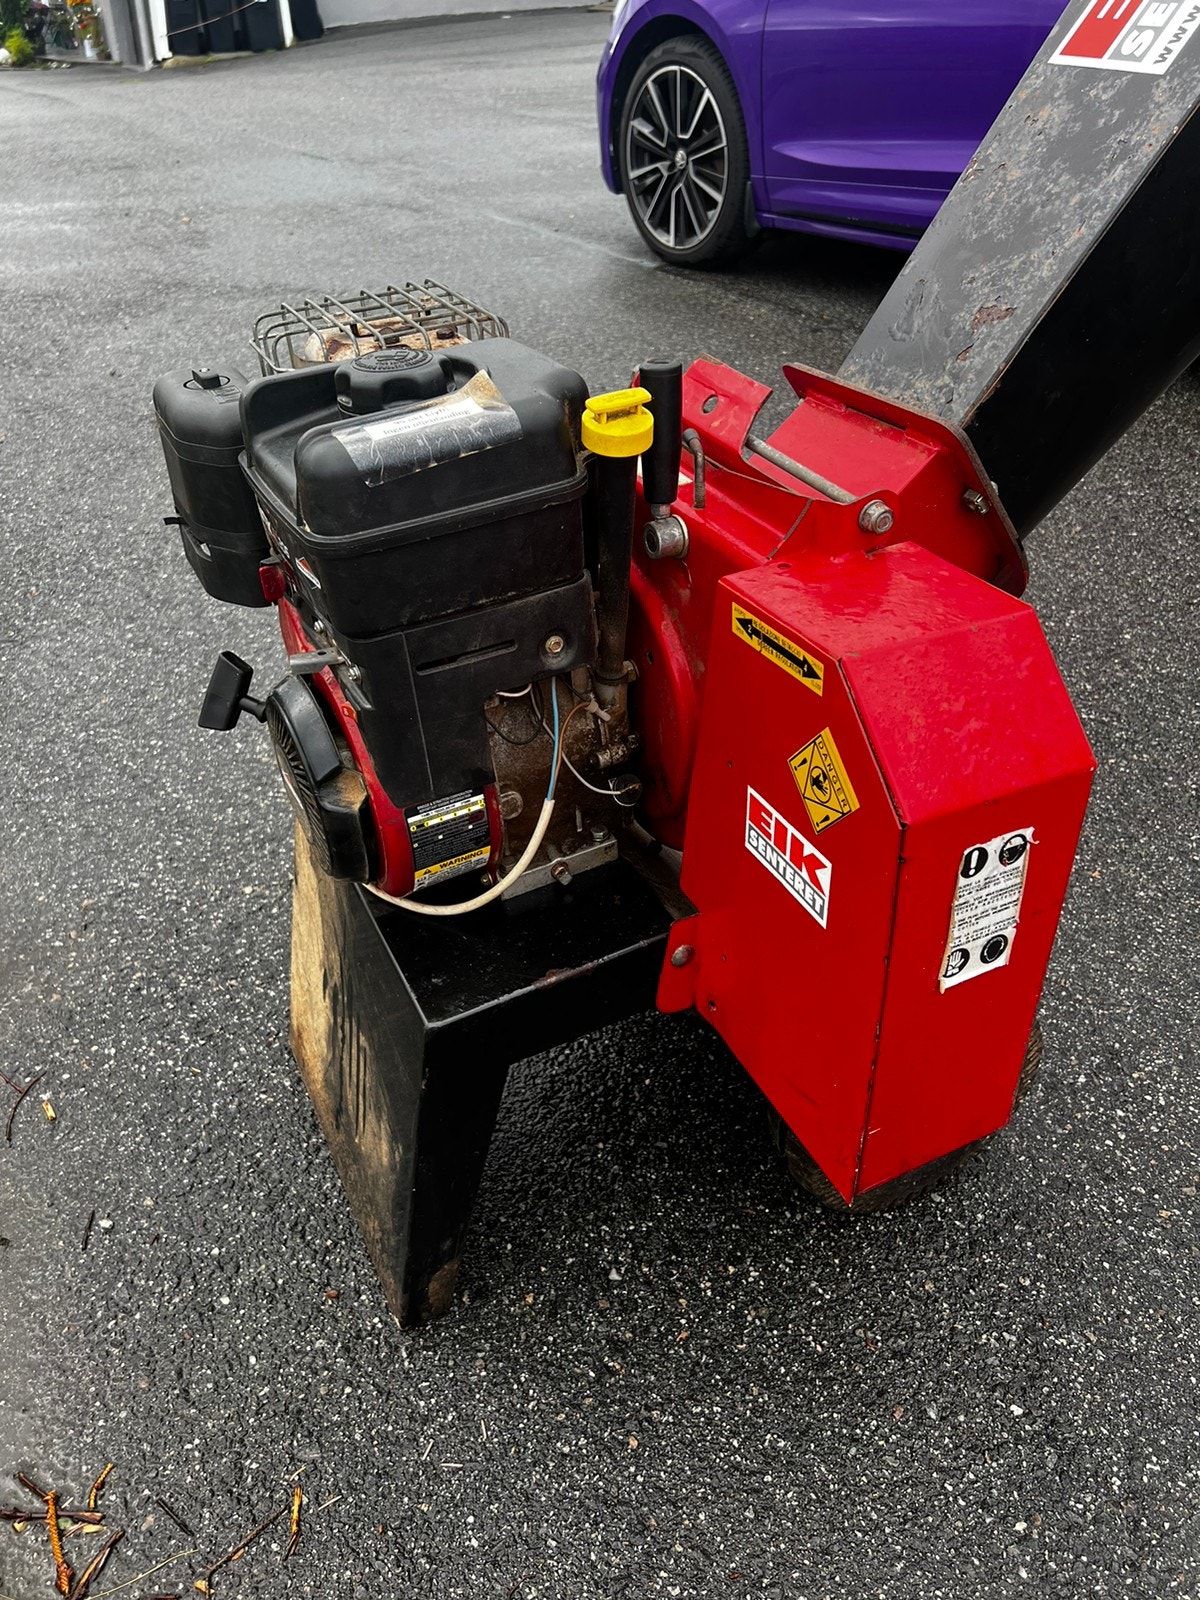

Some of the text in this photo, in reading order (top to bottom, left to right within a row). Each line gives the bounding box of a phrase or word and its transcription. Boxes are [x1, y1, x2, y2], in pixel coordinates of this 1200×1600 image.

[1120, 2, 1178, 58] SE
[817, 740, 849, 809] DANGER
[439, 850, 483, 869] WARNING
[748, 793, 828, 897] EIK
[749, 829, 825, 914] SENTERET
